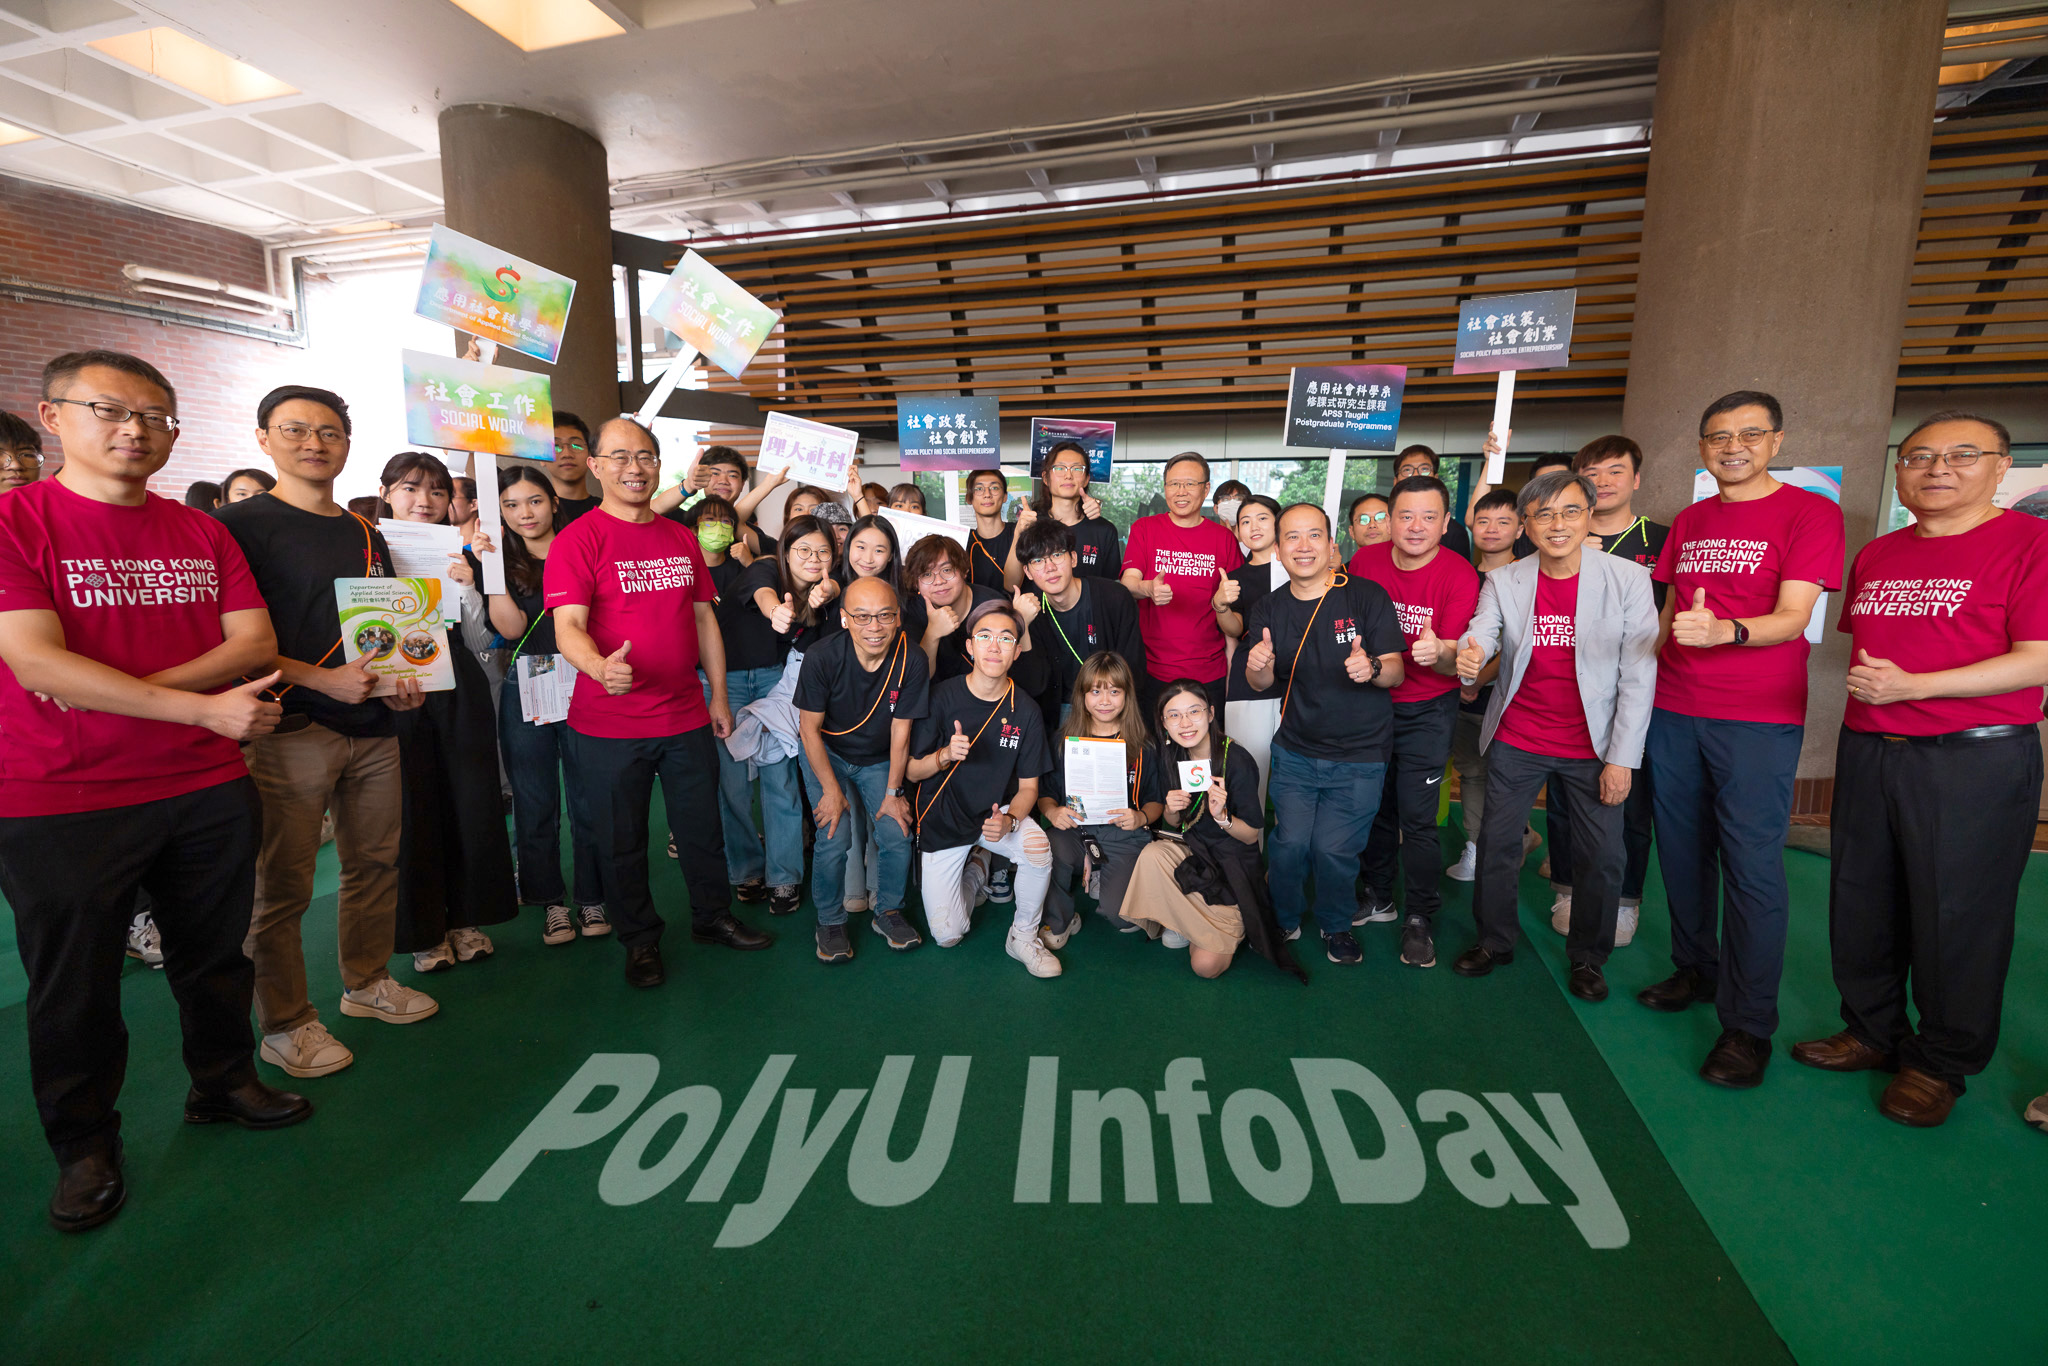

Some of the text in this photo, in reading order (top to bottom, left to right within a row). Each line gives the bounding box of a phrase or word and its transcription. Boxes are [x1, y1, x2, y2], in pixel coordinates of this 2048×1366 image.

[680, 277, 756, 338] 社會工作
[429, 300, 469, 319] Department
[477, 317, 501, 331] Applied
[501, 327, 521, 338] Social
[522, 334, 549, 349] Sciences
[678, 300, 735, 349] SOCIAL WORK
[1466, 310, 1546, 332] 社會政策及
[1488, 325, 1558, 346] 社會創業
[1502, 347, 1517, 355] SOCIAL
[1518, 343, 1564, 354] ENTREPRENEURSHIP
[424, 379, 536, 417] 社會工作
[1306, 395, 1387, 411] 修課式研究生課程
[440, 409, 525, 435] SOCIAL WORK
[906, 413, 978, 429] 社會政策及
[1321, 410, 1369, 420] APSS Taught
[1295, 418, 1392, 431] Postgraduate Programmes
[928, 430, 988, 445] 社會創業
[765, 436, 846, 472] 理大社科
[904, 448, 919, 456] SOCIAL
[957, 447, 996, 455] ENTREPRENEURSHIP
[1682, 538, 1768, 551] THE HONG KONG
[1156, 548, 1215, 561] THE HONG KONG
[61, 558, 215, 572] THE HONG KONG
[614, 556, 692, 570] THE HONG KONG
[1155, 564, 1215, 577] UNIVERSITY
[1675, 560, 1761, 575] UNIVERSITY
[620, 575, 694, 593] UNIVERSITY
[1861, 578, 1973, 591] THE HONG KONG
[70, 587, 219, 608] UNIVERSITY
[1407, 604, 1434, 616] KONG
[1850, 601, 1962, 618] UNIVERSITY
[1333, 617, 1355, 629] 理大
[1539, 615, 1571, 624] HONG
[1534, 624, 1574, 636] LYTEC
[1001, 724, 1021, 736] 理大
[461, 1053, 1630, 1250] PolyU InfoDay
